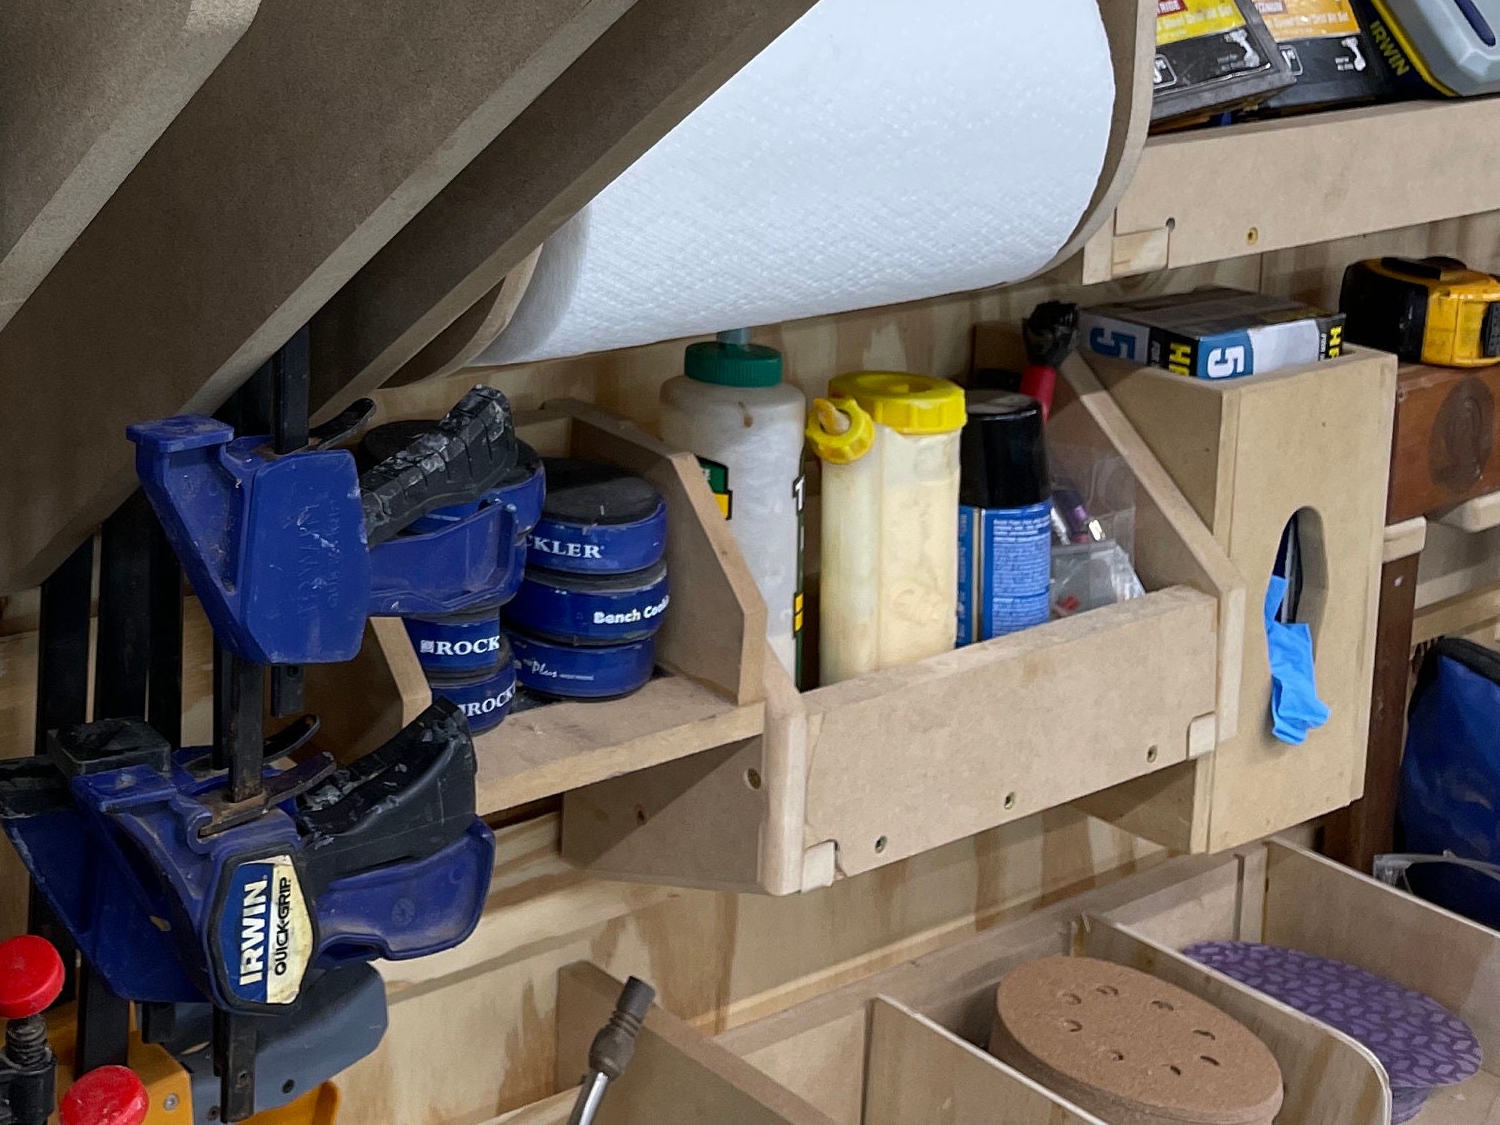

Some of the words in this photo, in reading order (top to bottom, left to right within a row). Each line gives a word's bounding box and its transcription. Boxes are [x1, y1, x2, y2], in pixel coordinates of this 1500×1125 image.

[1370, 20, 1410, 75] IRWIN
[1207, 345, 1245, 379] 5
[593, 608, 641, 624] Bench
[240, 880, 268, 985] IRWIN
[274, 877, 291, 976] QUICK-GRIP
